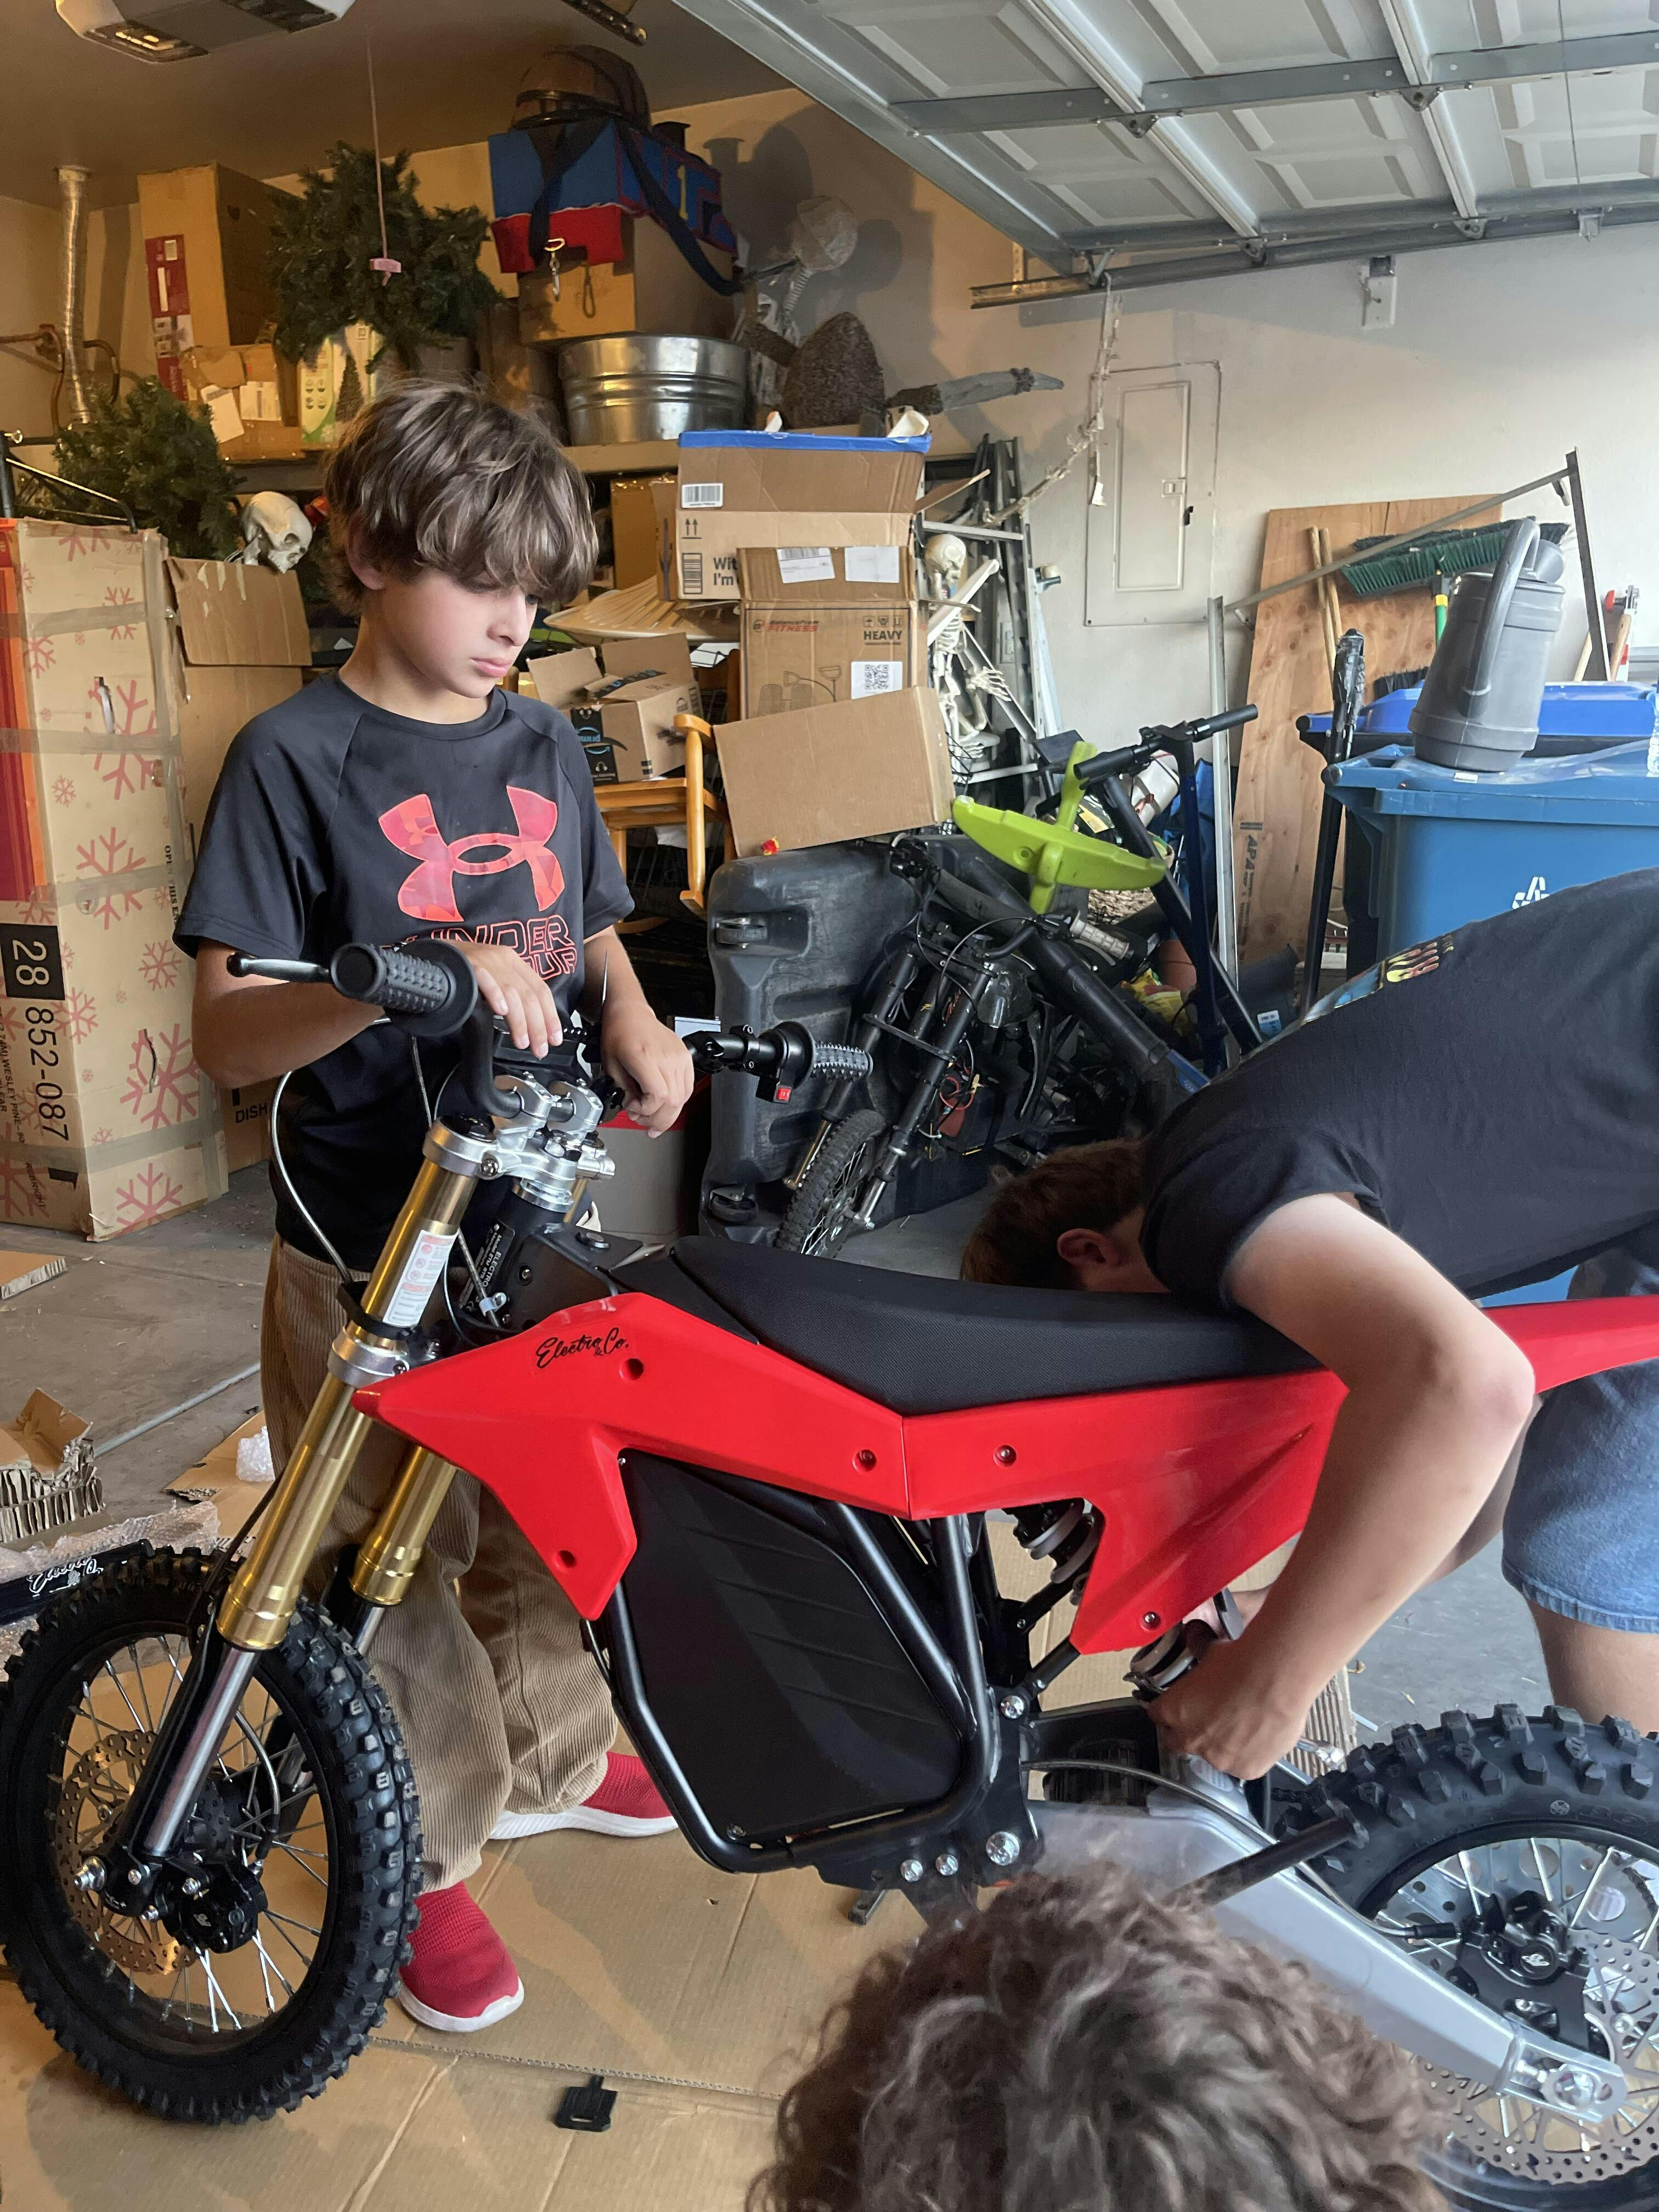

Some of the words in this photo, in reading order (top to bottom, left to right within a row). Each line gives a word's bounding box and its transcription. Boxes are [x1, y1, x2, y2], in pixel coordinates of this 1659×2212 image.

[713, 573, 734, 586] I'm
[864, 630, 902, 640] HEAVY
[12, 939, 49, 985] 28
[3, 1059, 15, 1101] WESLEY
[25, 1006, 69, 1141] 852-087
[235, 1102, 268, 1124] DISH
[483, 1251, 501, 1287] ELECTRO
[535, 1335, 603, 1369] Electro
[603, 1327, 630, 1355] Co.
